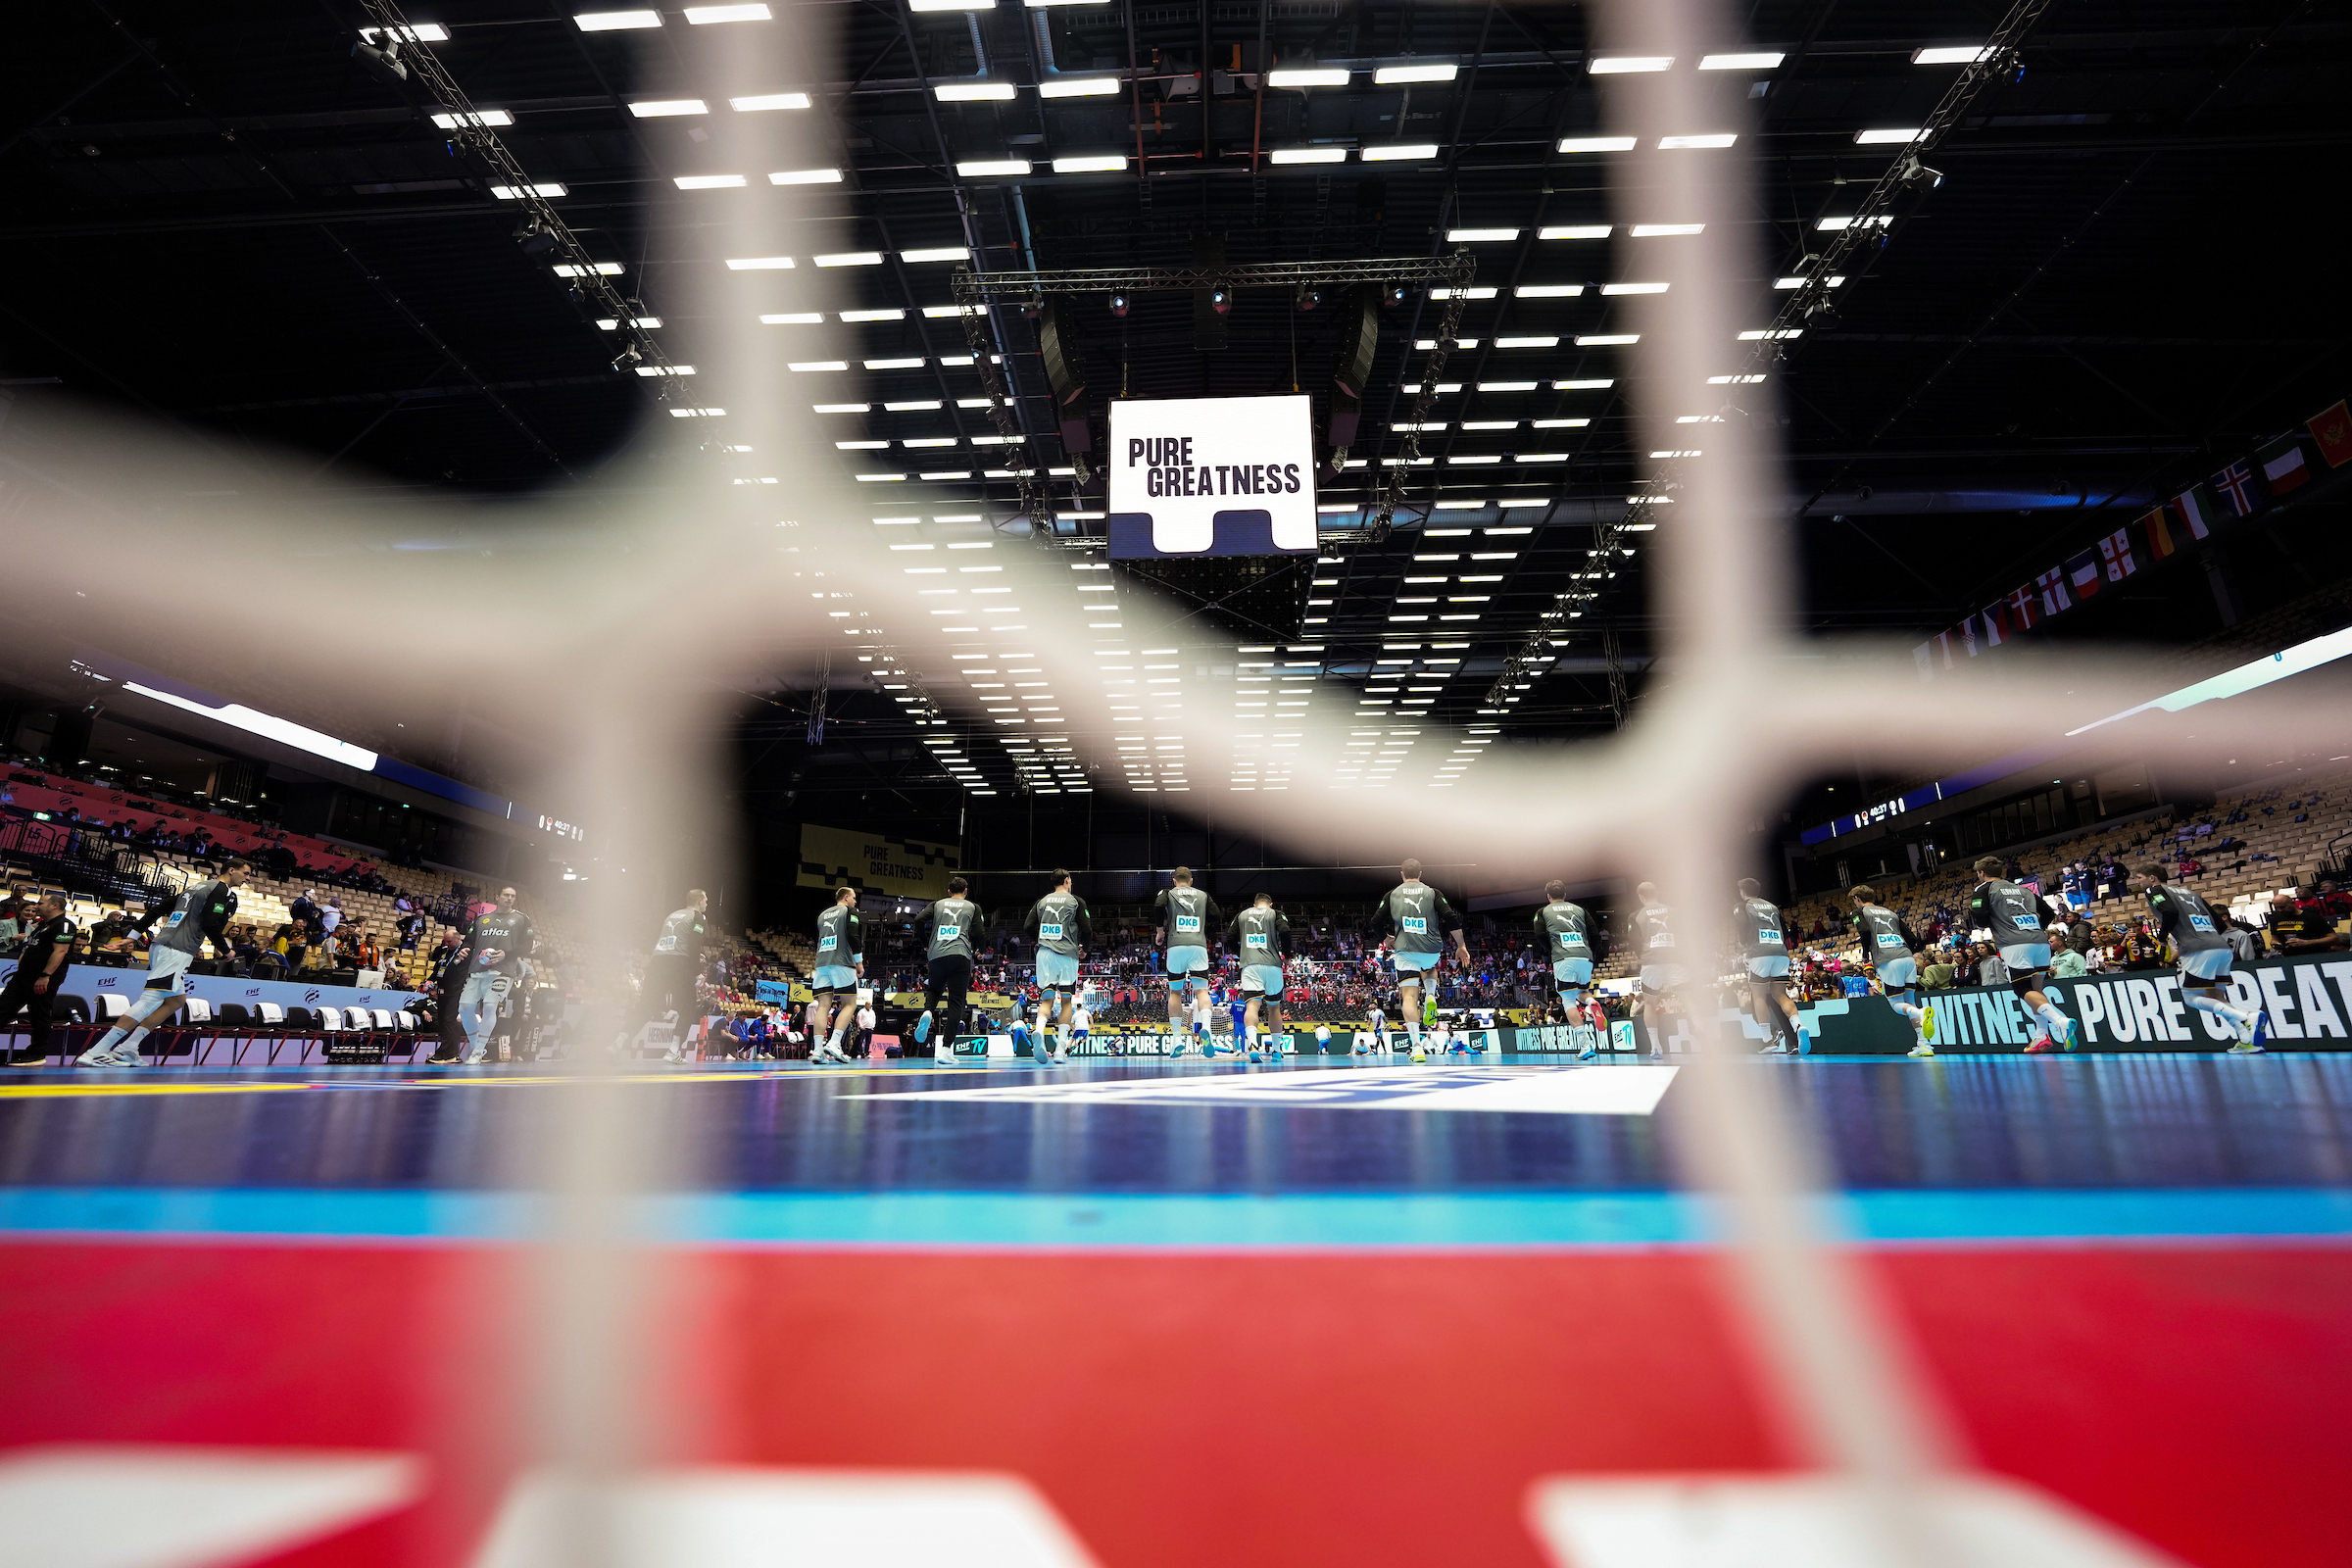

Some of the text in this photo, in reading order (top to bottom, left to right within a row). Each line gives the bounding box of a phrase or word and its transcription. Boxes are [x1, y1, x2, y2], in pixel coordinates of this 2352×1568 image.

[1129, 437, 1193, 467] PURE
[1148, 464, 1300, 497] GREATNESS
[864, 844, 889, 861] PURE
[869, 860, 924, 881] GREATNESS
[1178, 917, 1198, 927] DKB
[1404, 918, 1425, 928] DKB
[2014, 915, 2036, 925] DKB
[481, 927, 509, 937] atlas
[1041, 925, 1061, 934] DKB
[1248, 935, 1266, 944] DKB
[1652, 934, 1672, 944] DKB
[1760, 931, 1780, 940] DKB
[98, 977, 118, 986] EHF
[2074, 976, 2193, 1043] PURE
[648, 1027, 673, 1044] HERNIN
[1515, 1028, 1542, 1051] WITNESS
[1541, 1026, 1557, 1051] PURE
[1622, 1023, 1633, 1047] TV
[956, 1041, 970, 1052] EHF
[971, 1038, 988, 1054] TV
[1128, 1035, 1160, 1054] PURE
[1394, 1039, 1408, 1048] EHF
